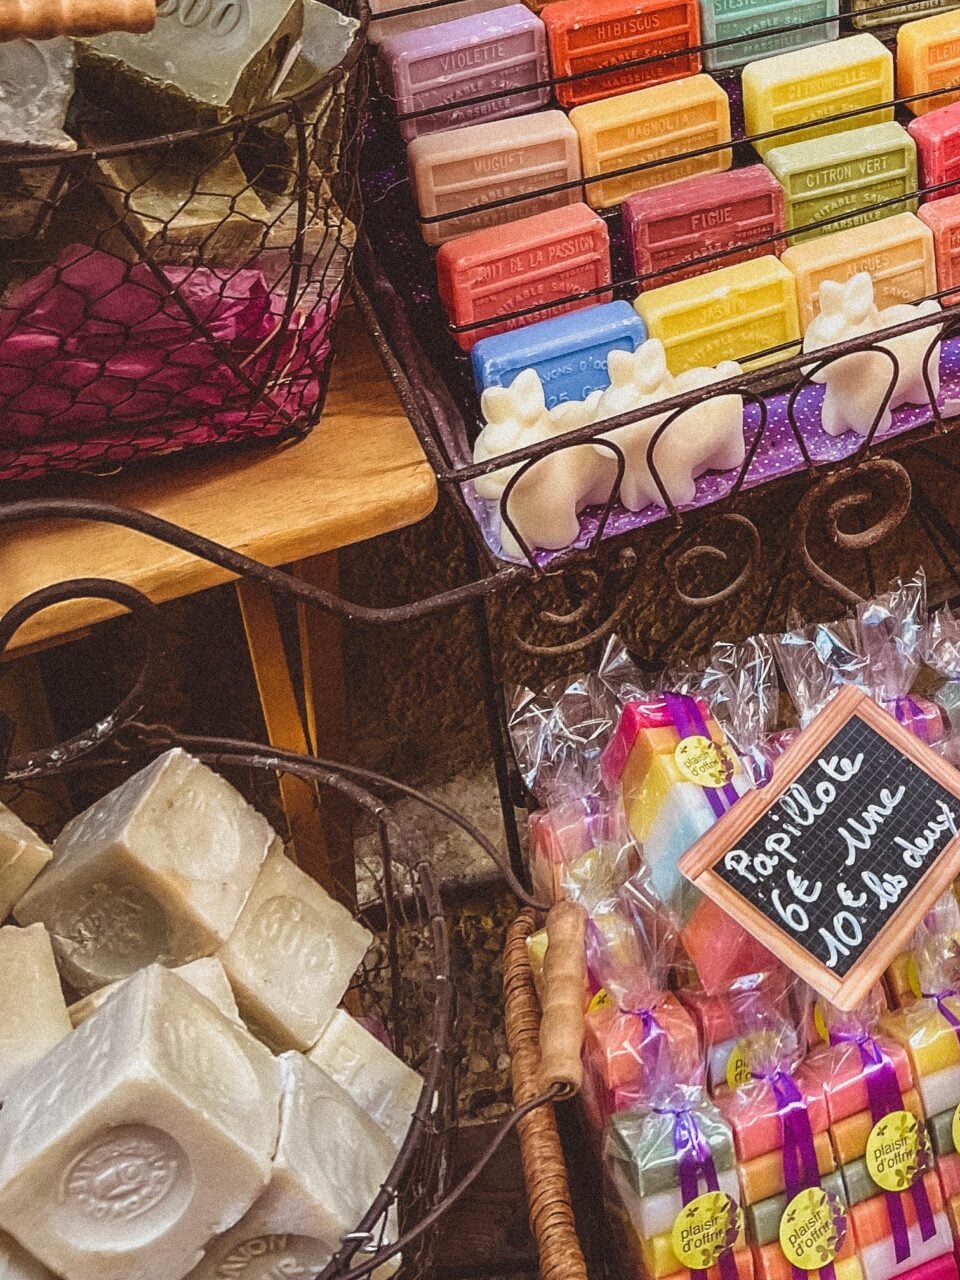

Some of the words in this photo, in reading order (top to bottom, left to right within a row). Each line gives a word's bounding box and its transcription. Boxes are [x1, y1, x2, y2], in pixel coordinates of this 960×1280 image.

[597, 15, 660, 40] HIBISCUS
[439, 45, 506, 72] VIOLETTE
[806, 161, 852, 188] CITRON
[857, 156, 888, 174] VERT
[691, 206, 733, 231] FIGUE
[510, 256, 525, 273] DE
[528, 250, 544, 267] LA
[549, 234, 595, 261] PASSION
[724, 753, 864, 884] Papillote
[772, 869, 823, 932] 6€
[818, 882, 868, 968] 10€
[861, 870, 908, 910] les
[893, 799, 959, 869] deux
